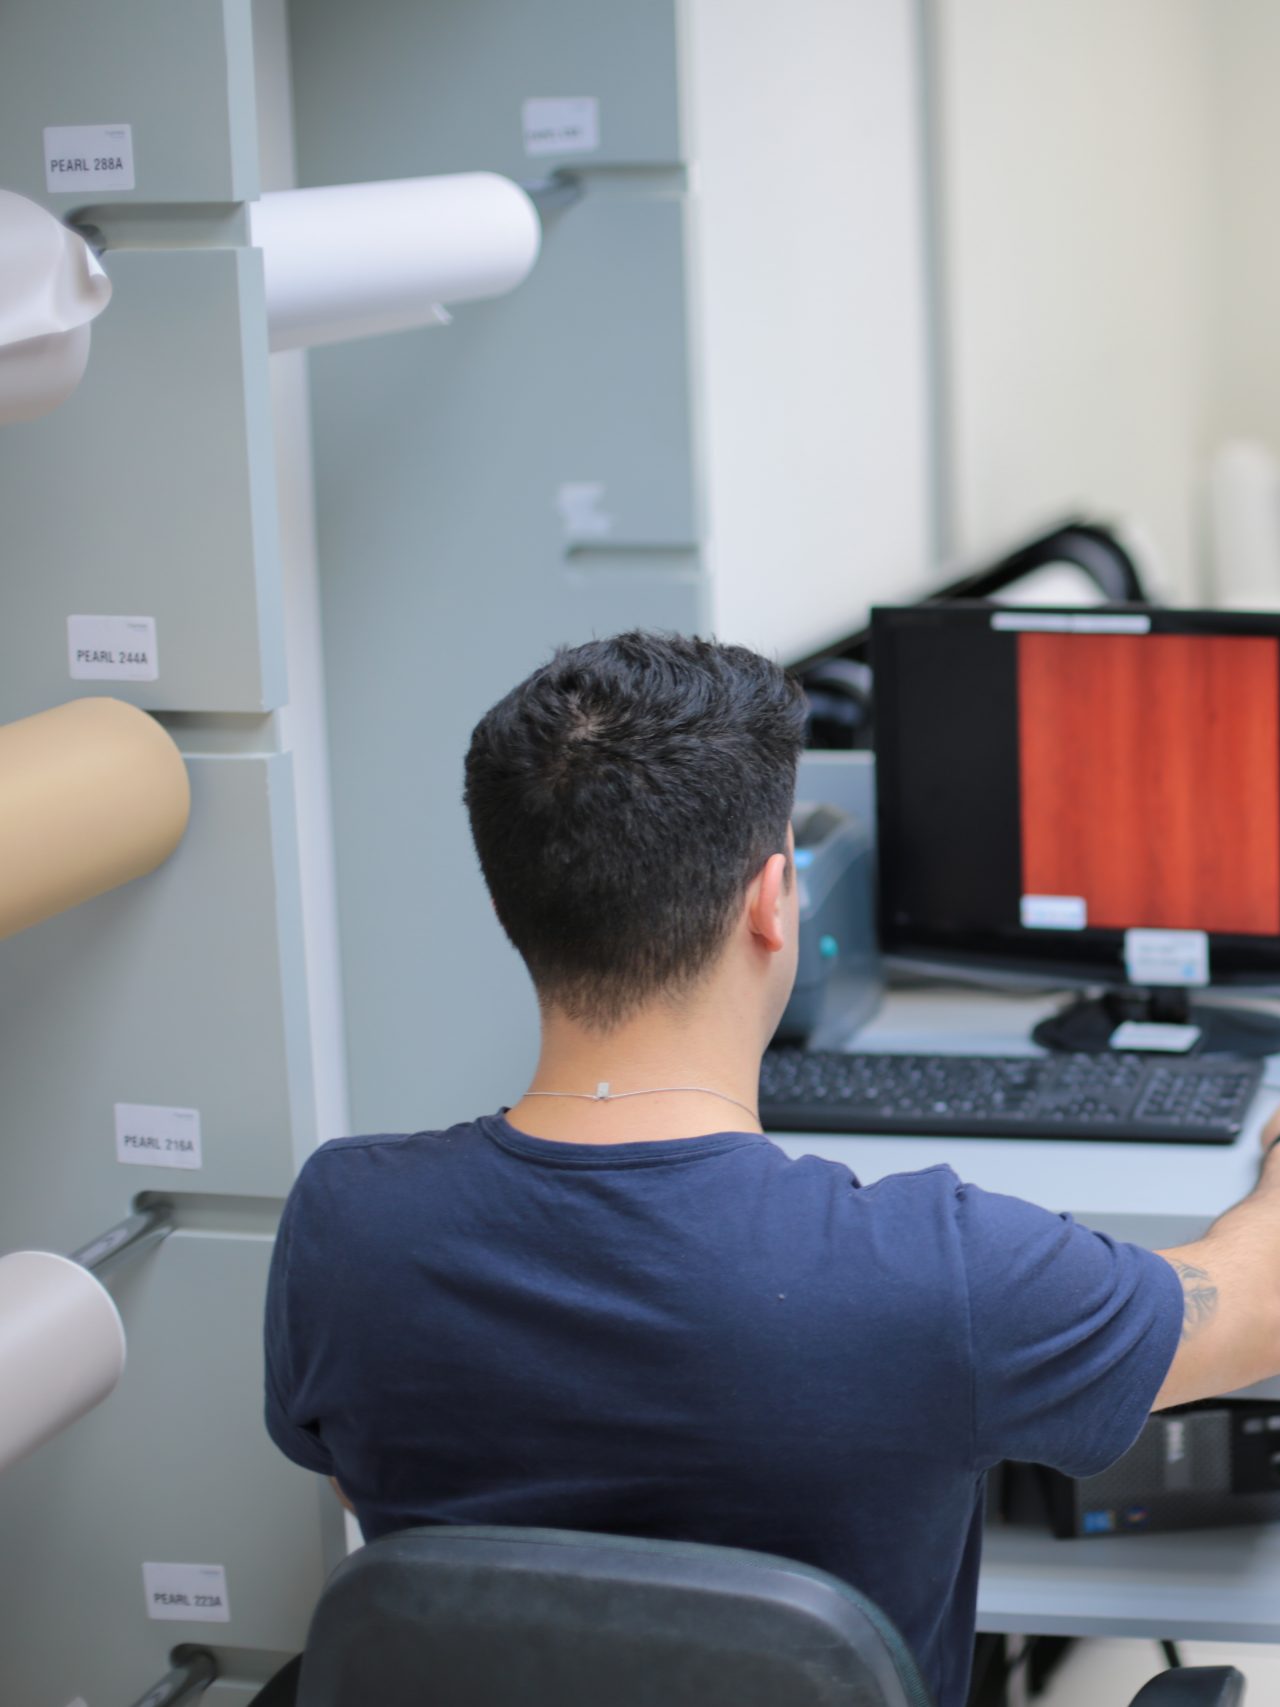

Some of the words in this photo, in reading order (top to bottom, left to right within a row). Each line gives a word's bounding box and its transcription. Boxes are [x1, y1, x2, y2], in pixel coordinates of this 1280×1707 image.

[50, 158, 90, 173] PEARL
[93, 157, 124, 171] 288A
[76, 649, 115, 664] PEARL
[123, 1135, 162, 1150] PEARL
[153, 1592, 192, 1607] PEARL
